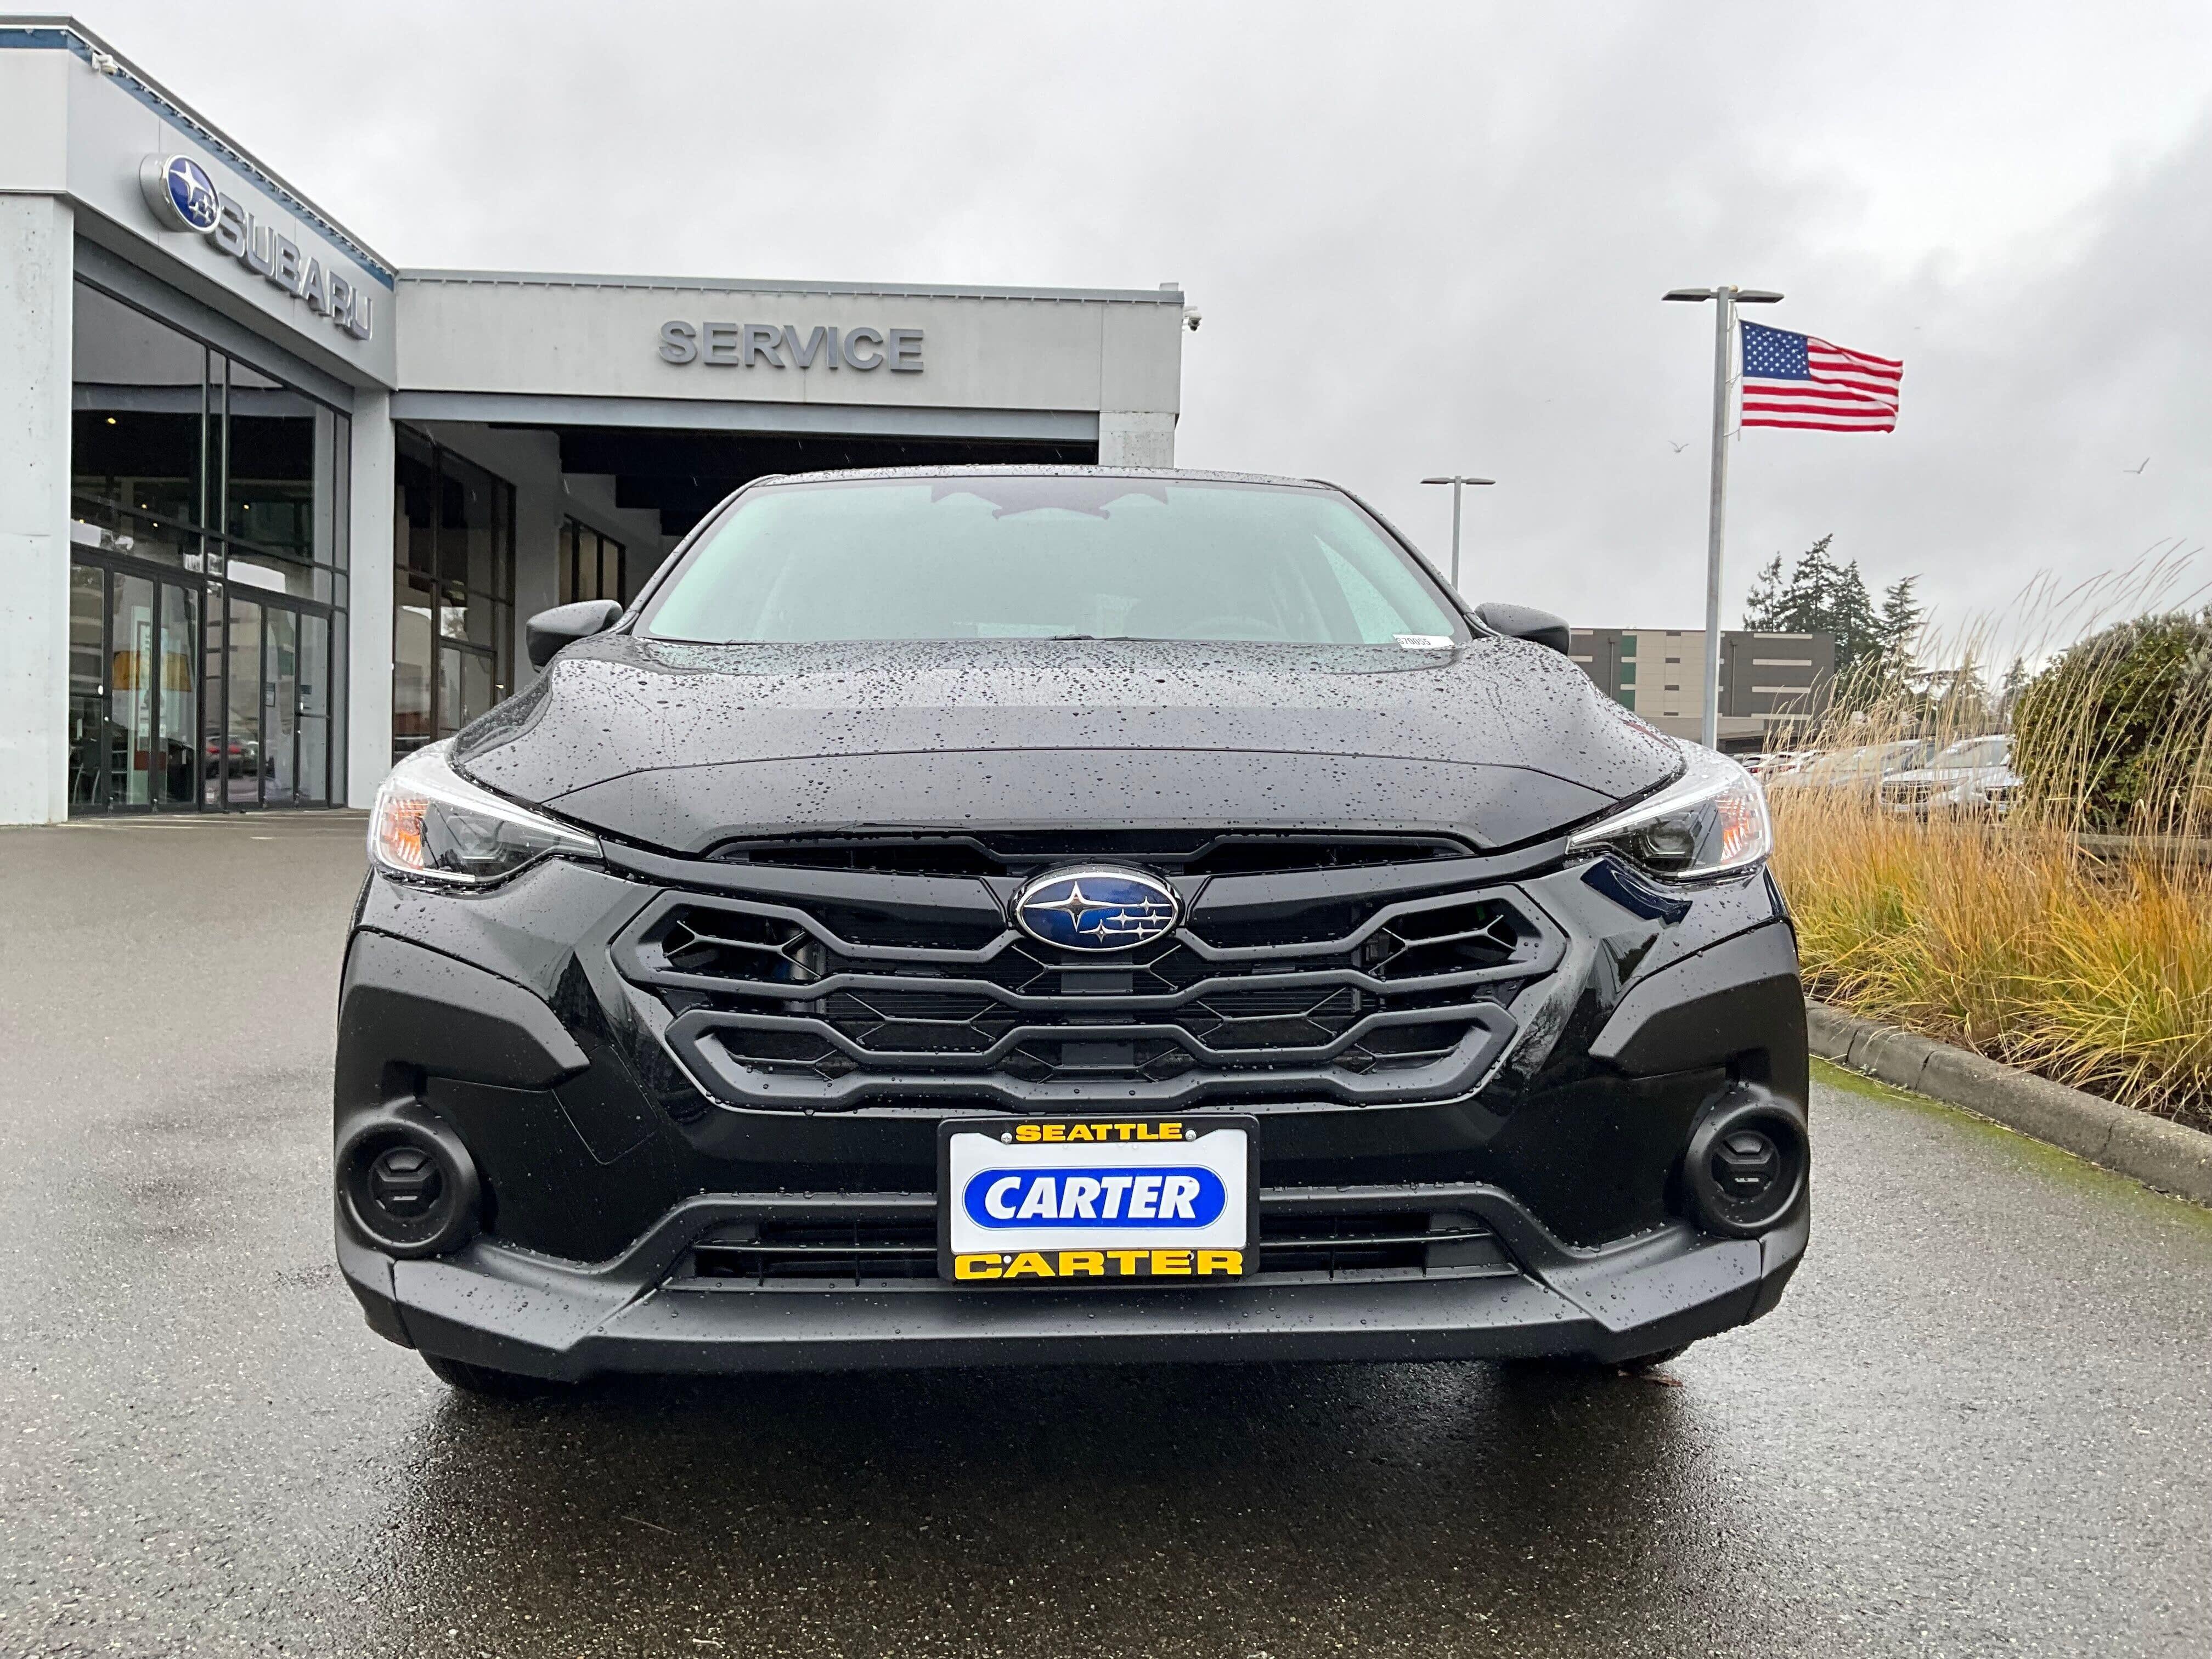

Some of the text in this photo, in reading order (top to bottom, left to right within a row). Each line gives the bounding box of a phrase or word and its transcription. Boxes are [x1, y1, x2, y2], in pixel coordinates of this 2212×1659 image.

[212, 192, 373, 341] SUBARU
[658, 320, 924, 371] SERVICE
[1015, 1122, 1182, 1142] SEATTLE
[985, 1176, 1200, 1219] CARTER
[954, 1250, 1244, 1280] CARTER
